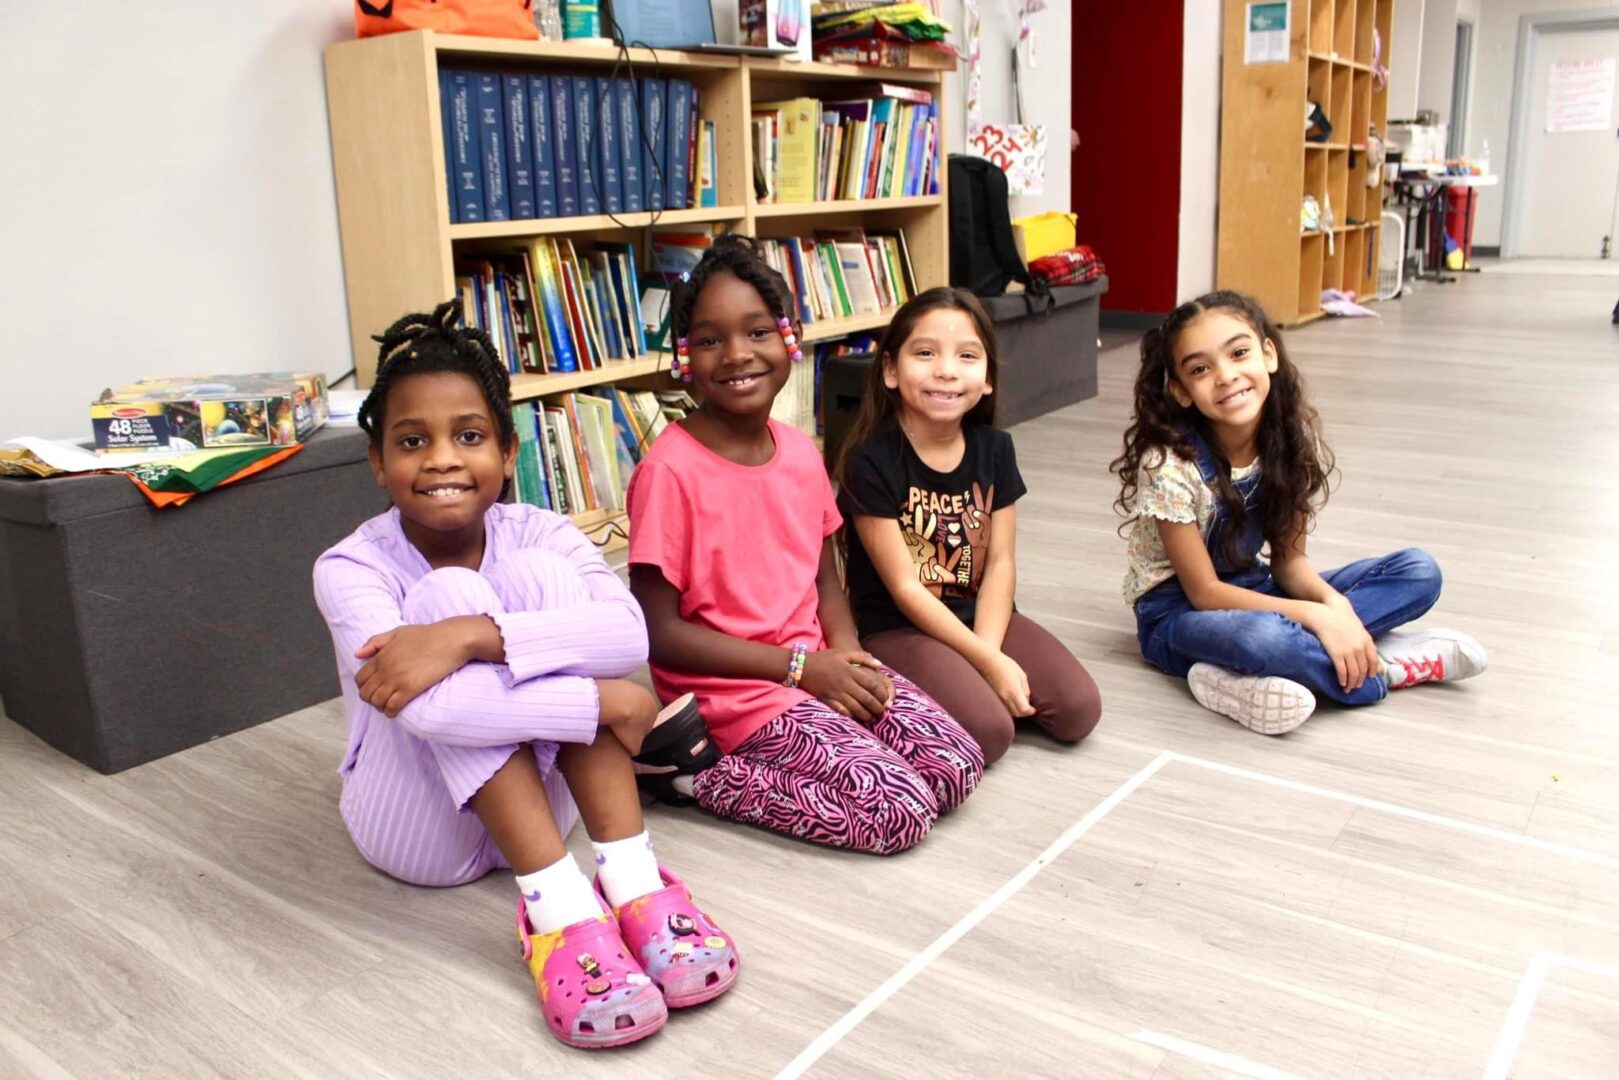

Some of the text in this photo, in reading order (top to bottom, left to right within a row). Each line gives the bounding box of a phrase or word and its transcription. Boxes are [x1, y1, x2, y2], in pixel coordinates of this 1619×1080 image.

[991, 137, 1023, 172] 24
[109, 419, 132, 435] 48
[908, 486, 964, 514] PEACE
[937, 514, 960, 544] LOVE
[957, 545, 971, 587] TOGETHE
